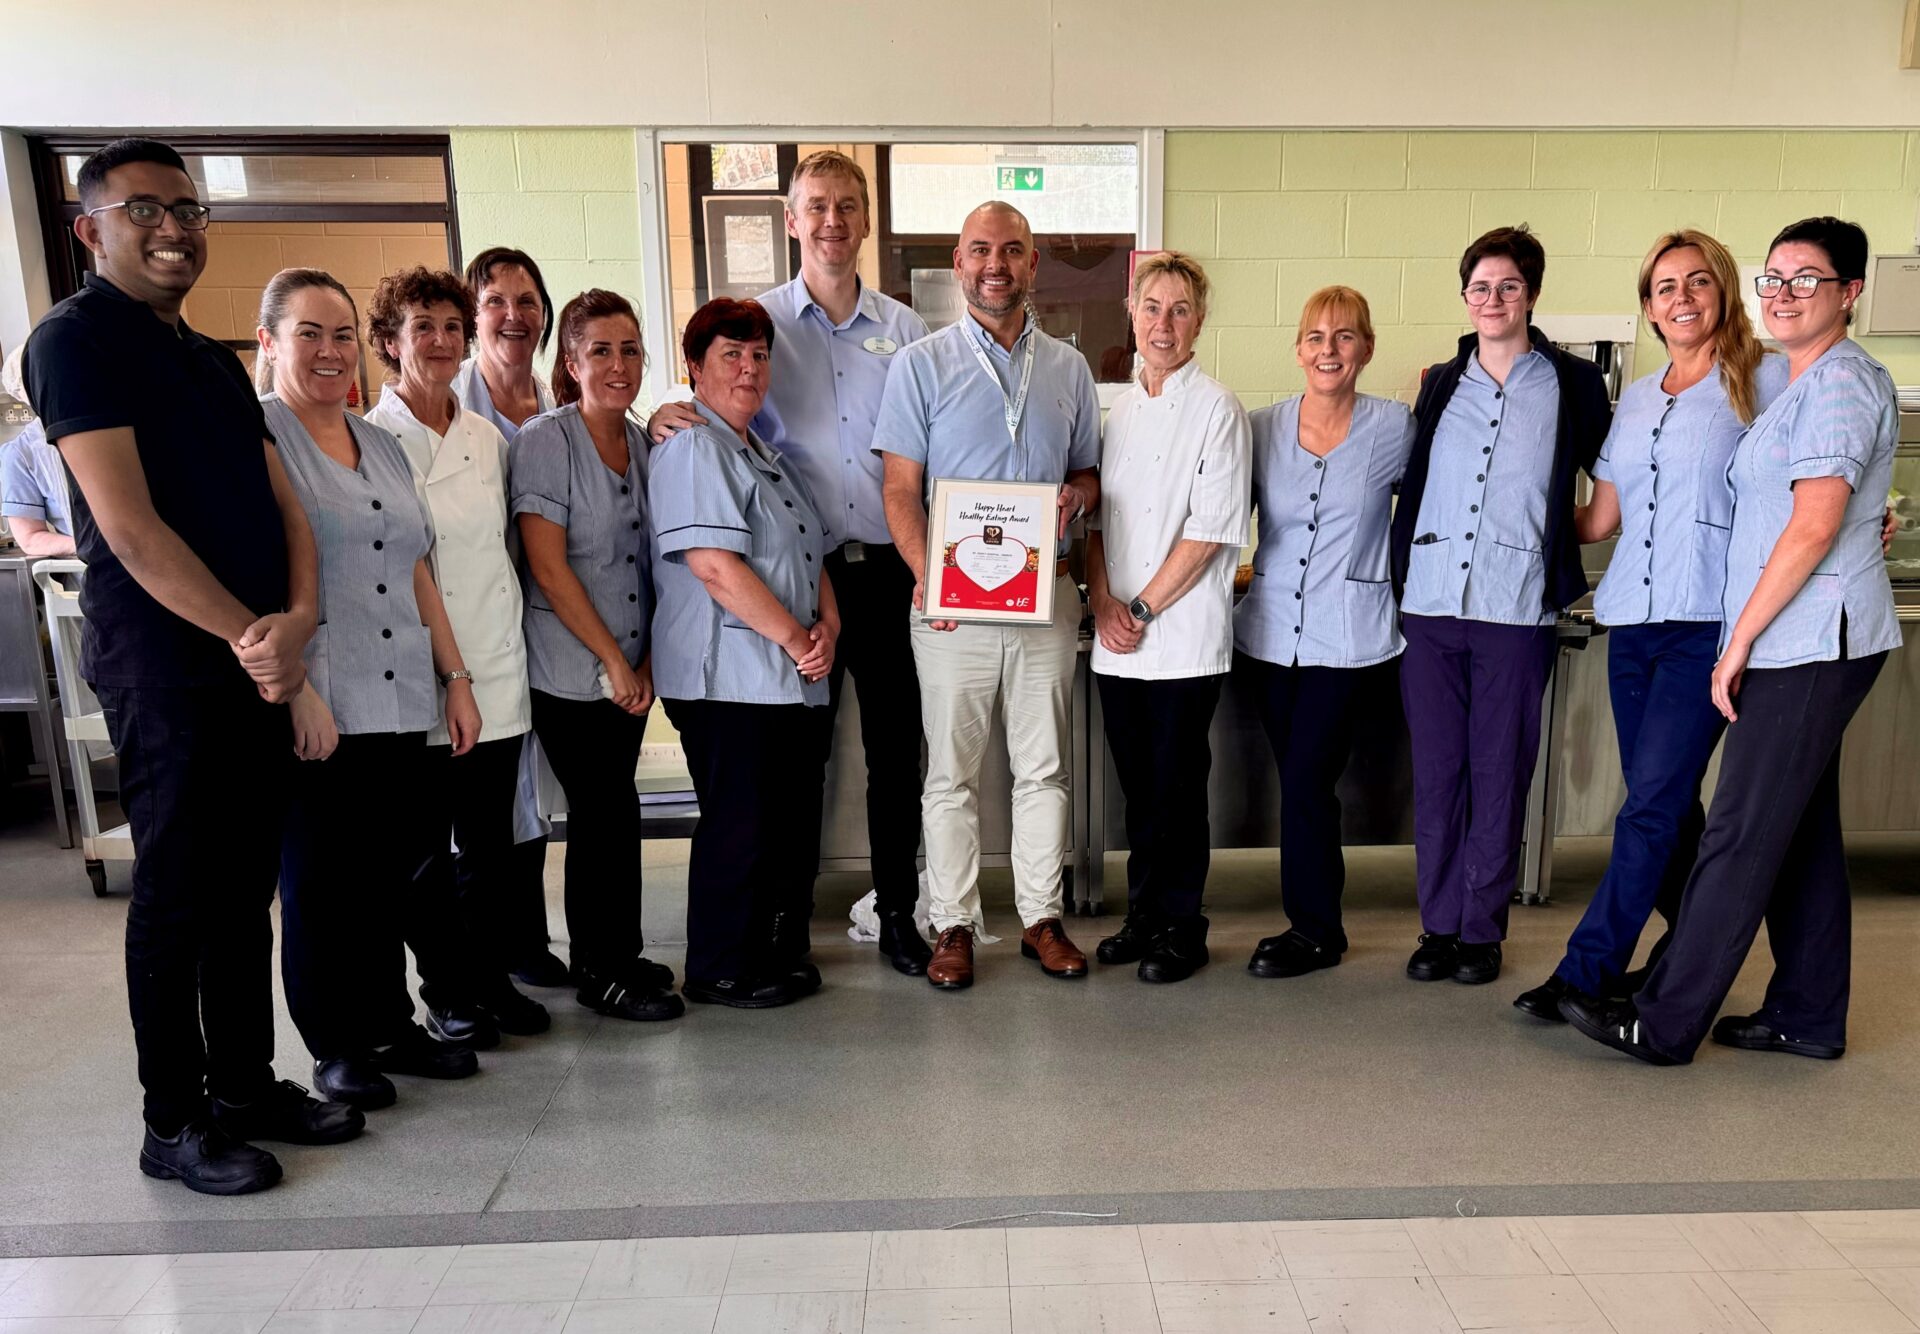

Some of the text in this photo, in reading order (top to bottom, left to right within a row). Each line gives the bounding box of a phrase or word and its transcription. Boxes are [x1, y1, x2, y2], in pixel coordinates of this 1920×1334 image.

[974, 502, 1016, 512] Happy Heart
[959, 511, 1030, 523] Healthy Eating Award
